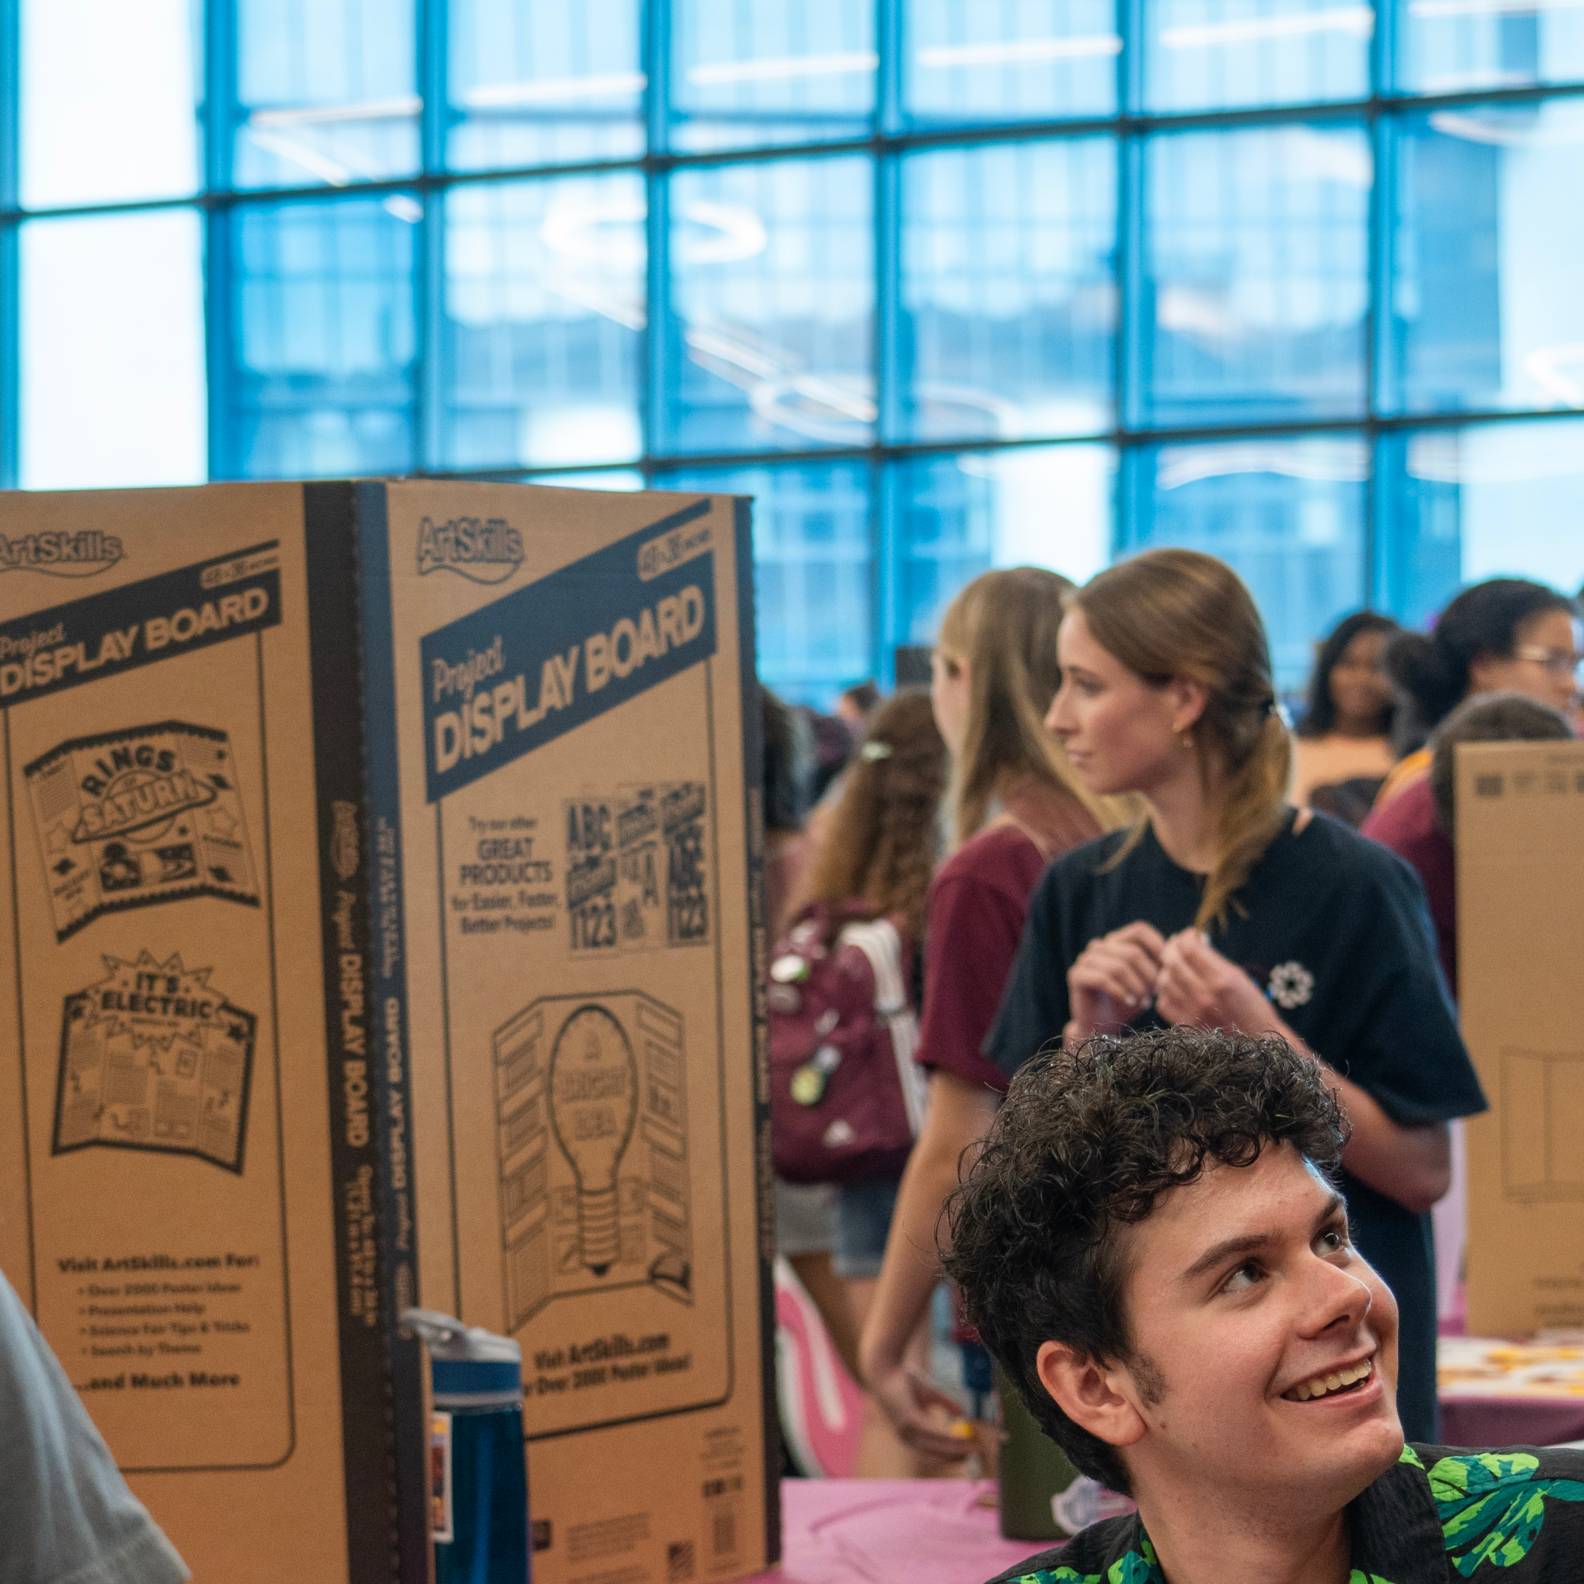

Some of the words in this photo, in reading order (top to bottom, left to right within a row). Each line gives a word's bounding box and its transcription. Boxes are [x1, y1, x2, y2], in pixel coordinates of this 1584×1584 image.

[144, 587, 269, 651] BOARD
[432, 634, 504, 703] Project
[434, 645, 580, 775] DISPLAY
[585, 585, 705, 694] BOARD
[81, 745, 175, 797] RINGS
[459, 862, 554, 885] PRODUCTS
[477, 837, 534, 861] GREAT
[100, 990, 214, 1019] ELECTRIC
[338, 953, 366, 1057] DISPLAY
[343, 1059, 369, 1148] BOARD
[58, 1256, 97, 1274] Visit
[130, 1373, 183, 1390] Much
[188, 1372, 241, 1389] More
